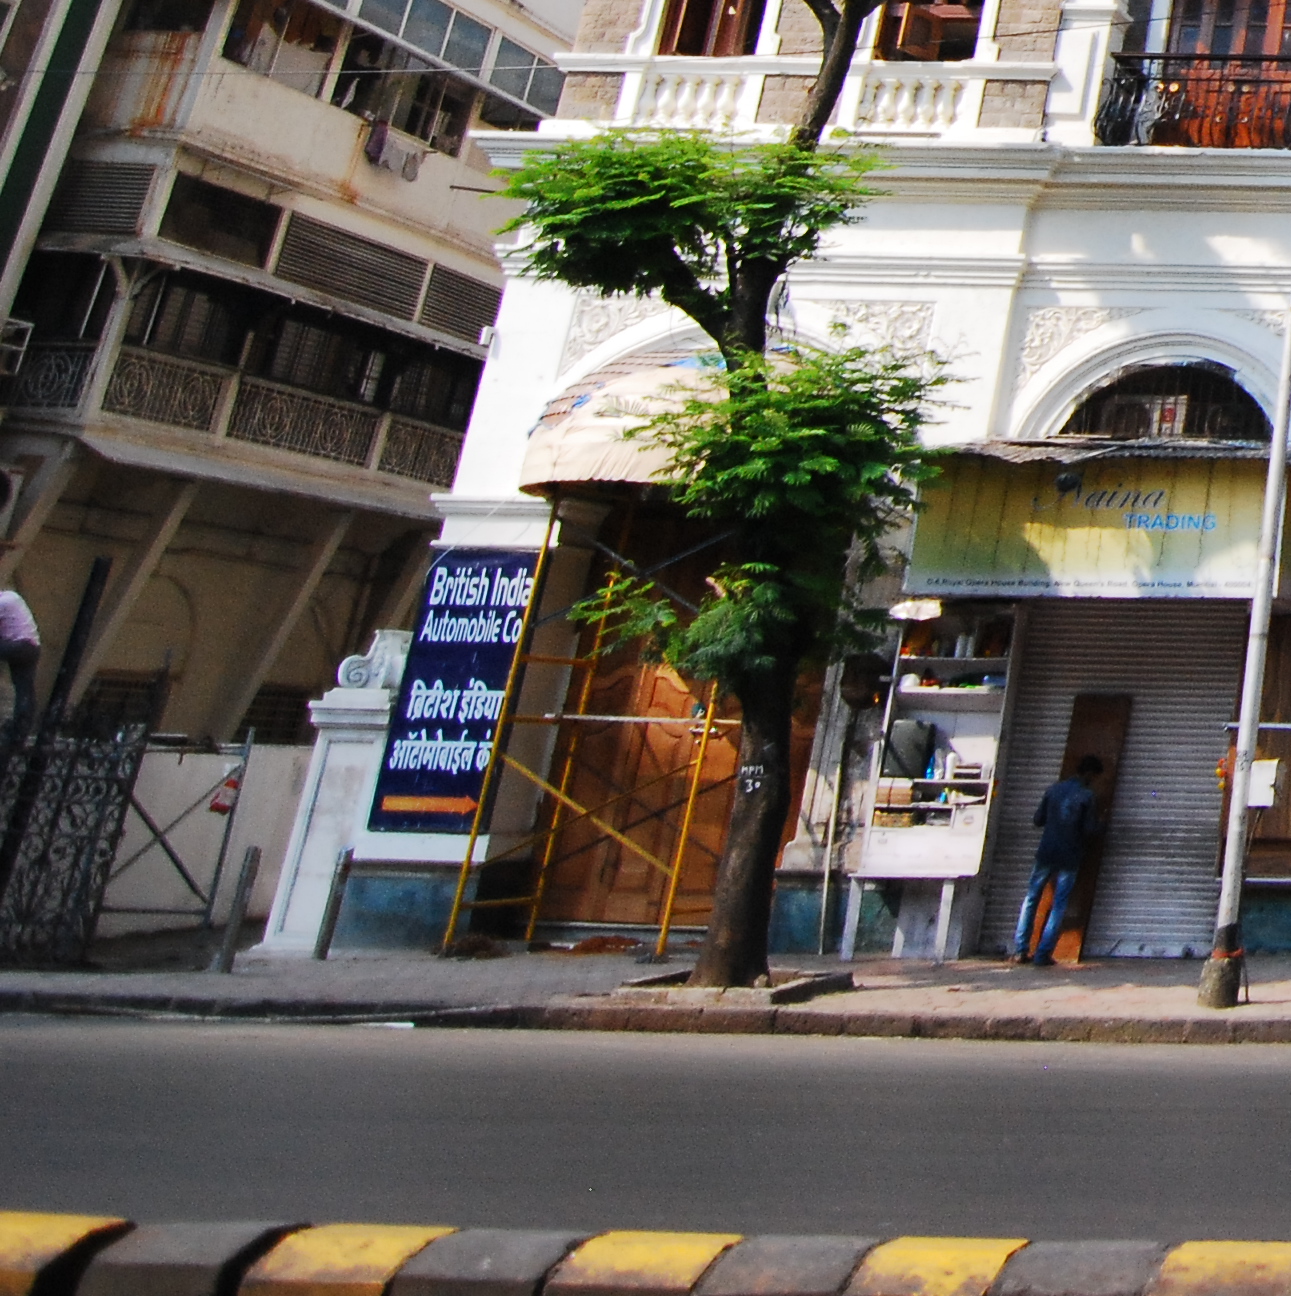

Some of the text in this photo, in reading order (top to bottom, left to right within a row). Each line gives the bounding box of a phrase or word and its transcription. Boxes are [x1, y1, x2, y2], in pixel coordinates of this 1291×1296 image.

[1125, 513, 1217, 531] TRADING
[429, 566, 534, 607] British India
[420, 610, 501, 642] Automobile
[745, 779, 761, 793] 30
